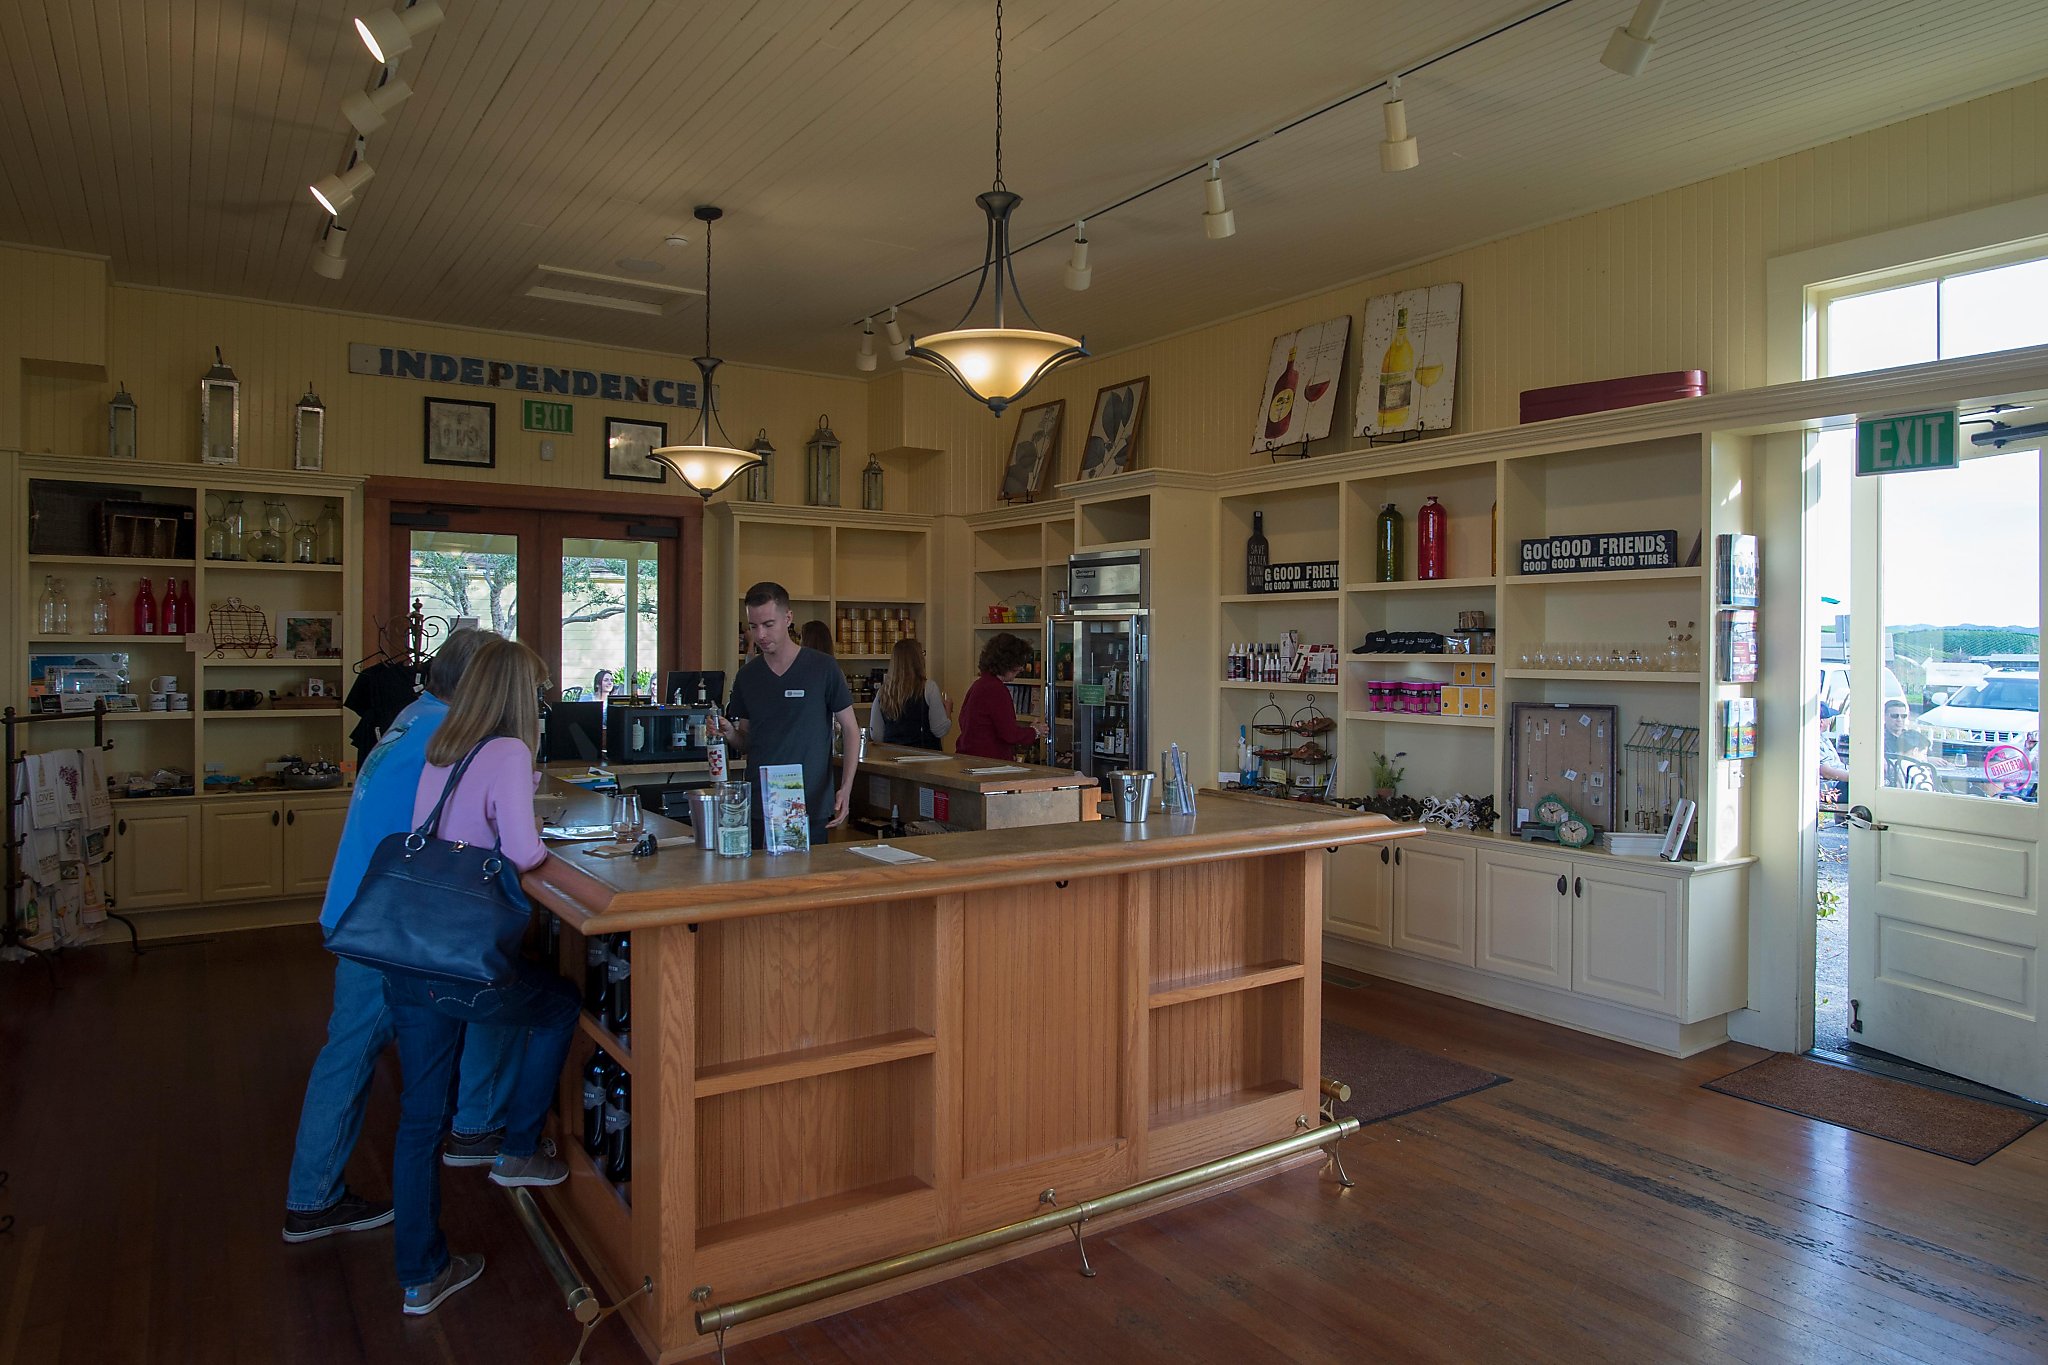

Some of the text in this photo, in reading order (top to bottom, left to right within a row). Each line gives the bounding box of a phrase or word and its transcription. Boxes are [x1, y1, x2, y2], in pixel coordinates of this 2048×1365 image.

[379, 348, 697, 408] INDEPENDENCE
[531, 402, 568, 431] EXIT
[1873, 416, 1945, 468] EXIT
[1250, 544, 1265, 555] SAVE
[1551, 534, 1668, 557] GOOD FRIENDS,
[1523, 561, 1548, 572] GOOD
[1551, 558, 1575, 569] GOOD
[1609, 555, 1635, 566] GOOD
[1639, 553, 1669, 565] TIMES
[1274, 566, 1301, 580] GOOD
[1274, 582, 1290, 591] GOOD
[1313, 580, 1330, 589] GOOD
[36, 792, 55, 803] LOVE
[91, 795, 110, 806] LOVE
